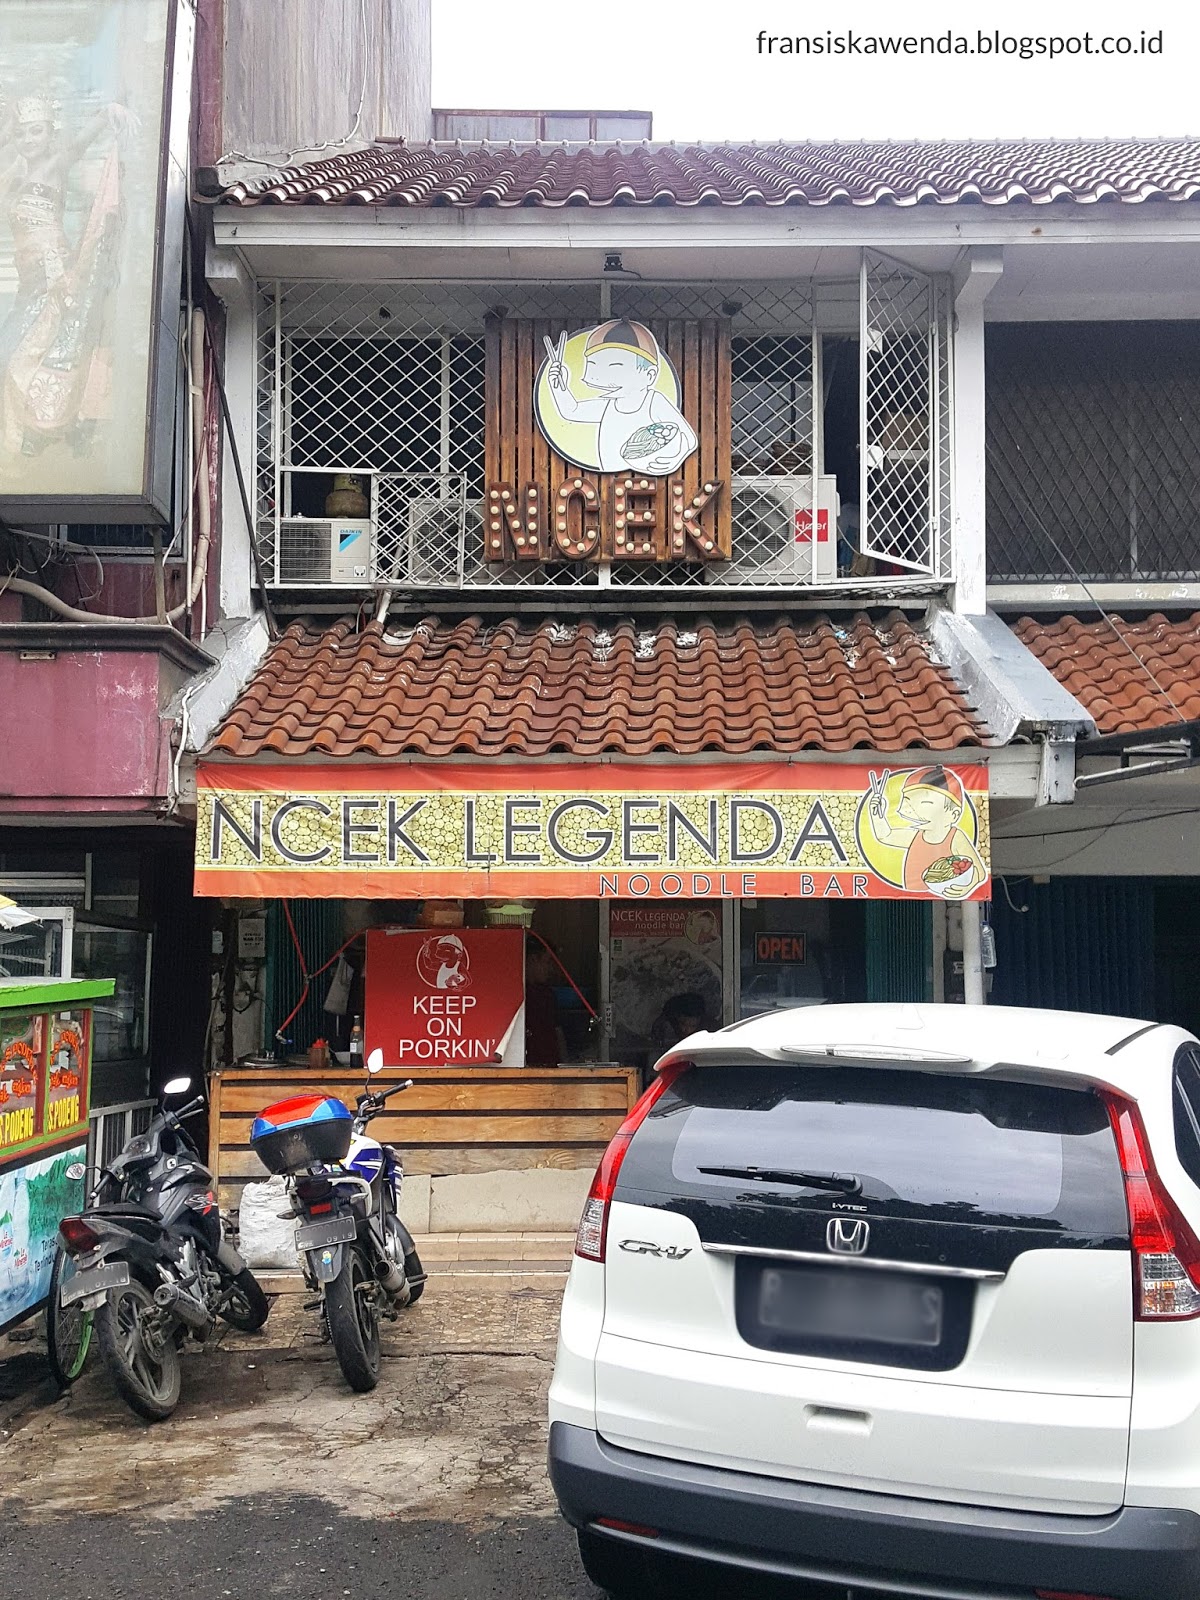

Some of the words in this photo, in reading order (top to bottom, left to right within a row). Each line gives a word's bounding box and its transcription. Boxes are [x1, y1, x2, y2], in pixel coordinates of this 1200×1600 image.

[488, 476, 726, 561] NCEK
[796, 520, 827, 530] Haer
[211, 797, 430, 863] NCEK
[465, 798, 849, 863] LEGENDA
[599, 873, 757, 896] NOODLE
[801, 873, 868, 897] BAR
[611, 910, 643, 922] NCEK
[644, 912, 686, 921] LEGENDA
[634, 921, 667, 930] noodle
[669, 921, 685, 930] bar
[757, 936, 803, 961] OPEN
[412, 995, 477, 1015] KEEP
[426, 1017, 463, 1037] ON
[398, 1038, 496, 1059] PORKIN'
[618, 1239, 693, 1260] CR-V
